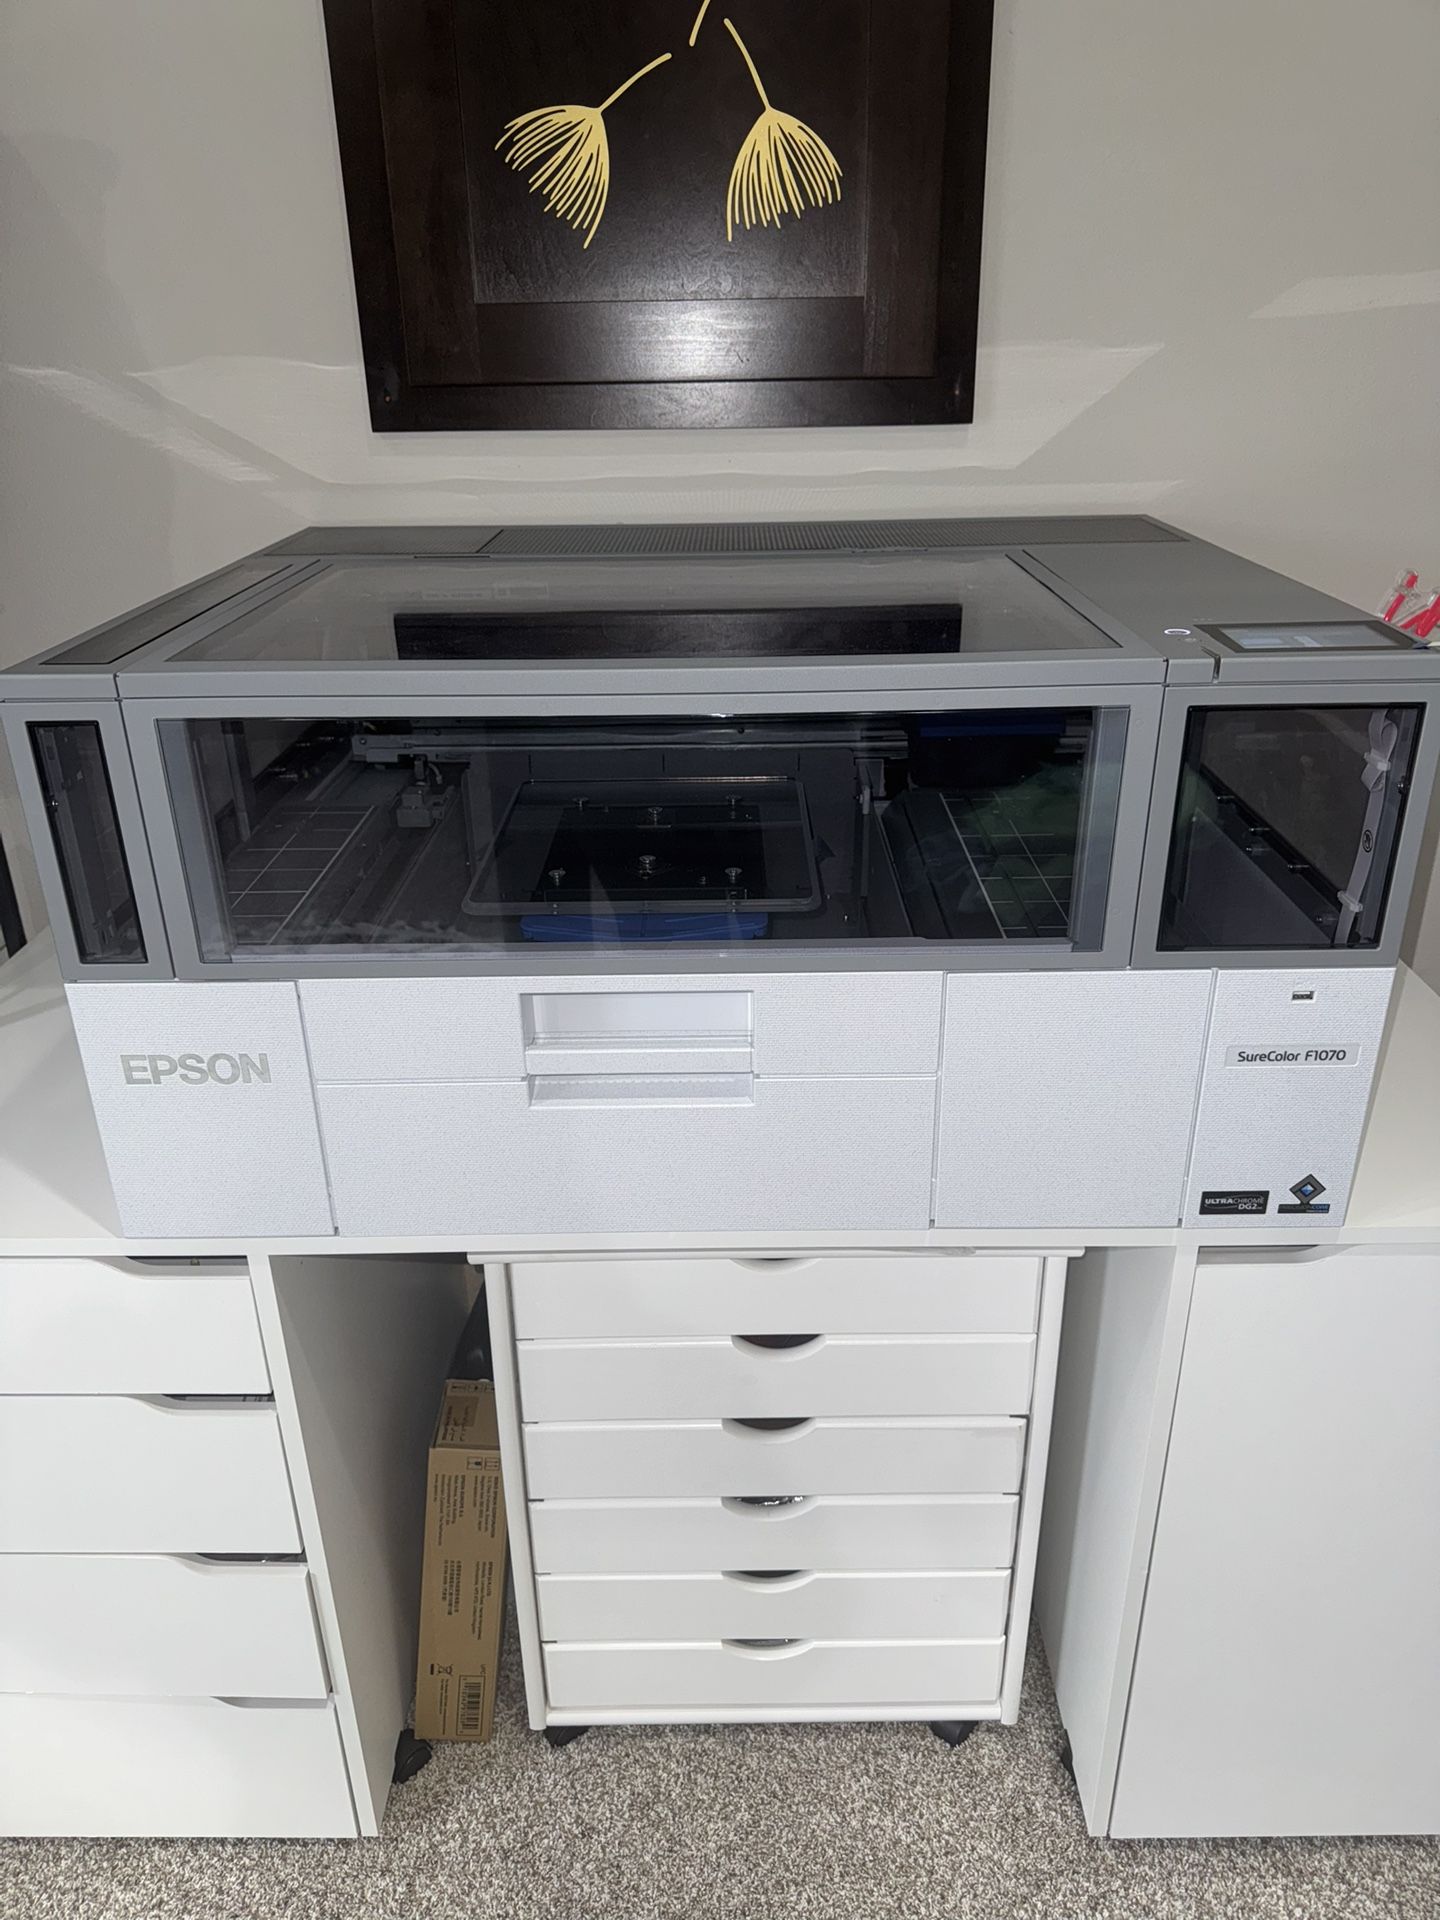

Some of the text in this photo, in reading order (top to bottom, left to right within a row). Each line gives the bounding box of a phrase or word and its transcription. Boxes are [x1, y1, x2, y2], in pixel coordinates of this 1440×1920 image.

[1237, 1049, 1347, 1063] SureColor F1070
[120, 1053, 272, 1085] EPSON
